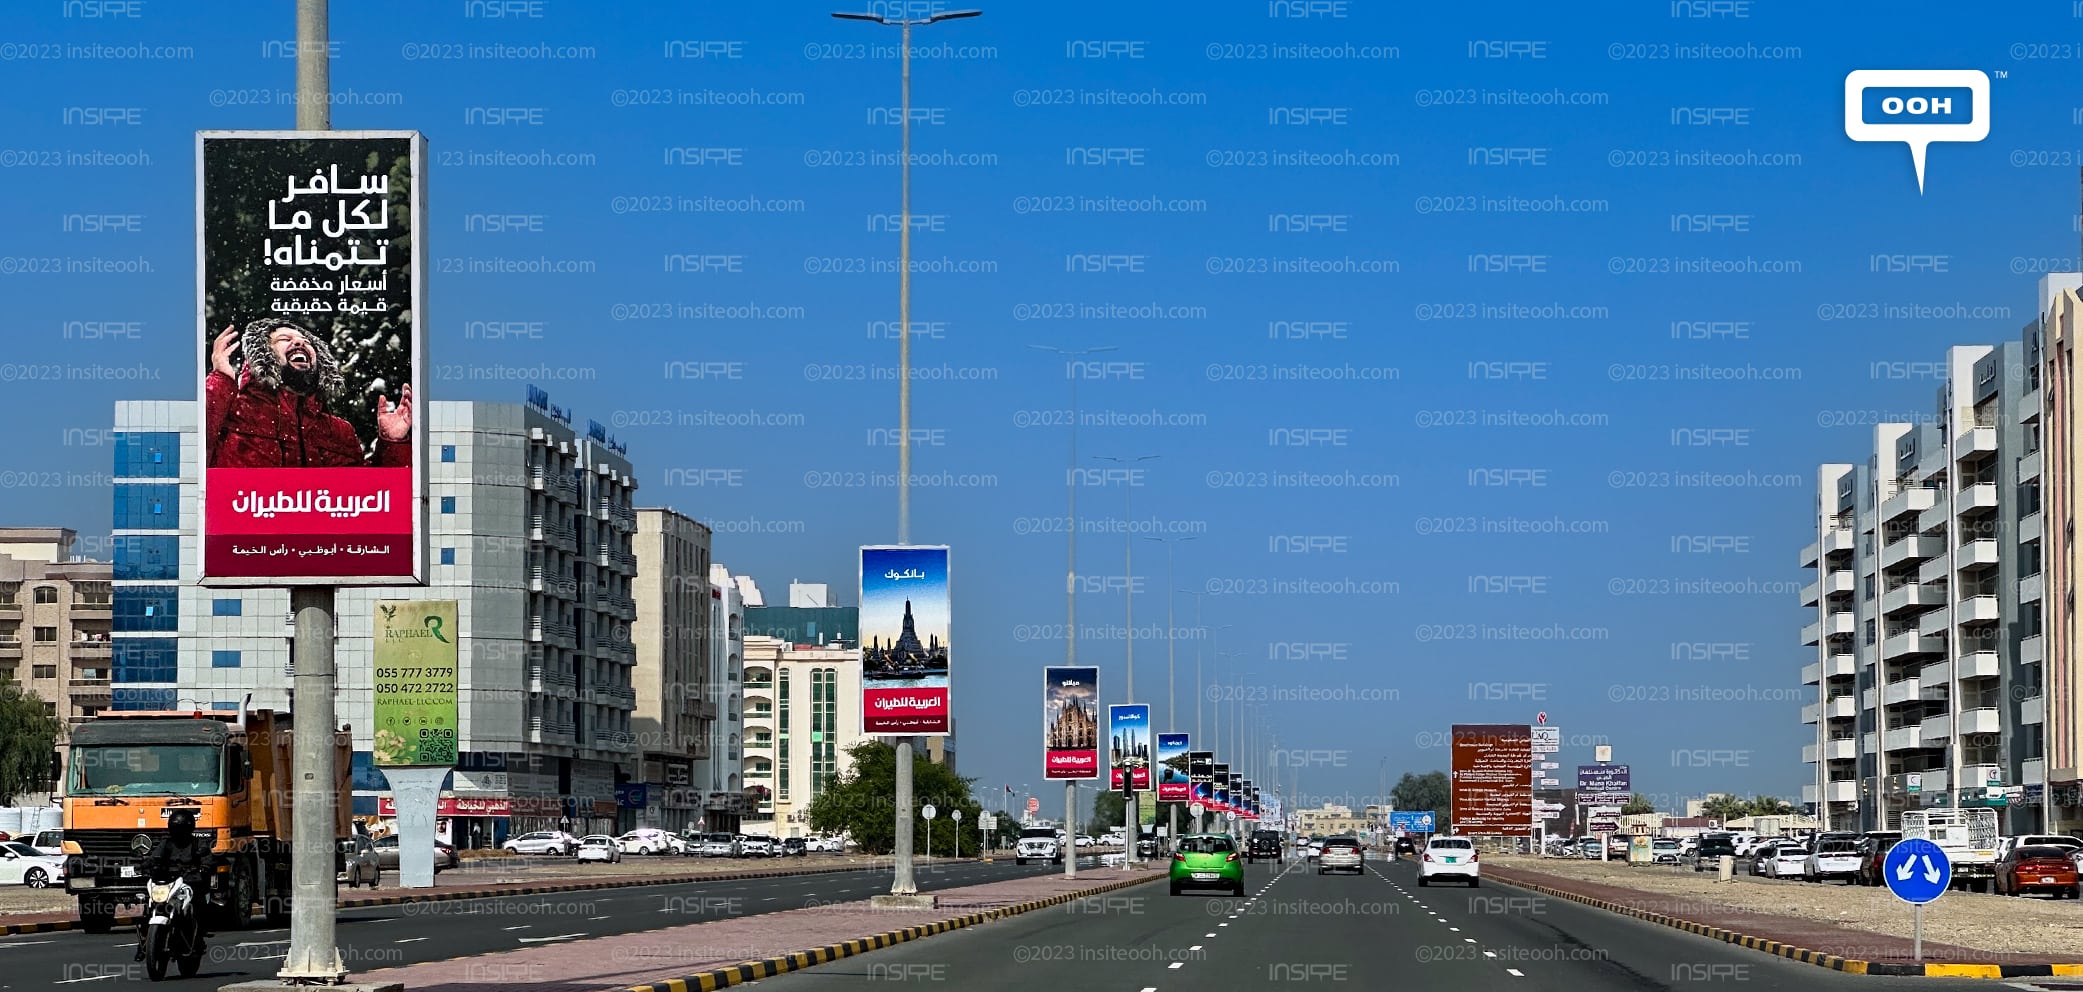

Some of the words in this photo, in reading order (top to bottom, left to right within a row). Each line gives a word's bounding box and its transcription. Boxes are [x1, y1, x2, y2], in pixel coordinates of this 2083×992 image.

[281, 163, 389, 203] سافر
[268, 199, 312, 230] ما
[322, 199, 389, 238] لكل
[263, 234, 390, 271] تتمناه!
[270, 277, 334, 291] مخفضة
[337, 269, 387, 295] أسعار
[270, 297, 333, 315] حقيقية
[337, 297, 387, 315] قيمة
[232, 489, 312, 518] للطيران
[314, 489, 390, 518] العربية
[232, 545, 267, 556] الخيمة
[269, 543, 289, 556] رأس
[298, 543, 337, 558] أبوظبي
[346, 543, 390, 555] الشارقة
[884, 568, 925, 581] بانكوك
[385, 629, 433, 638] RAPHAEL
[376, 667, 398, 678] 055
[401, 667, 422, 678] 777
[425, 667, 453, 678] 3779
[376, 683, 398, 694] 050
[400, 683, 422, 694] 472
[425, 683, 454, 693] 2722
